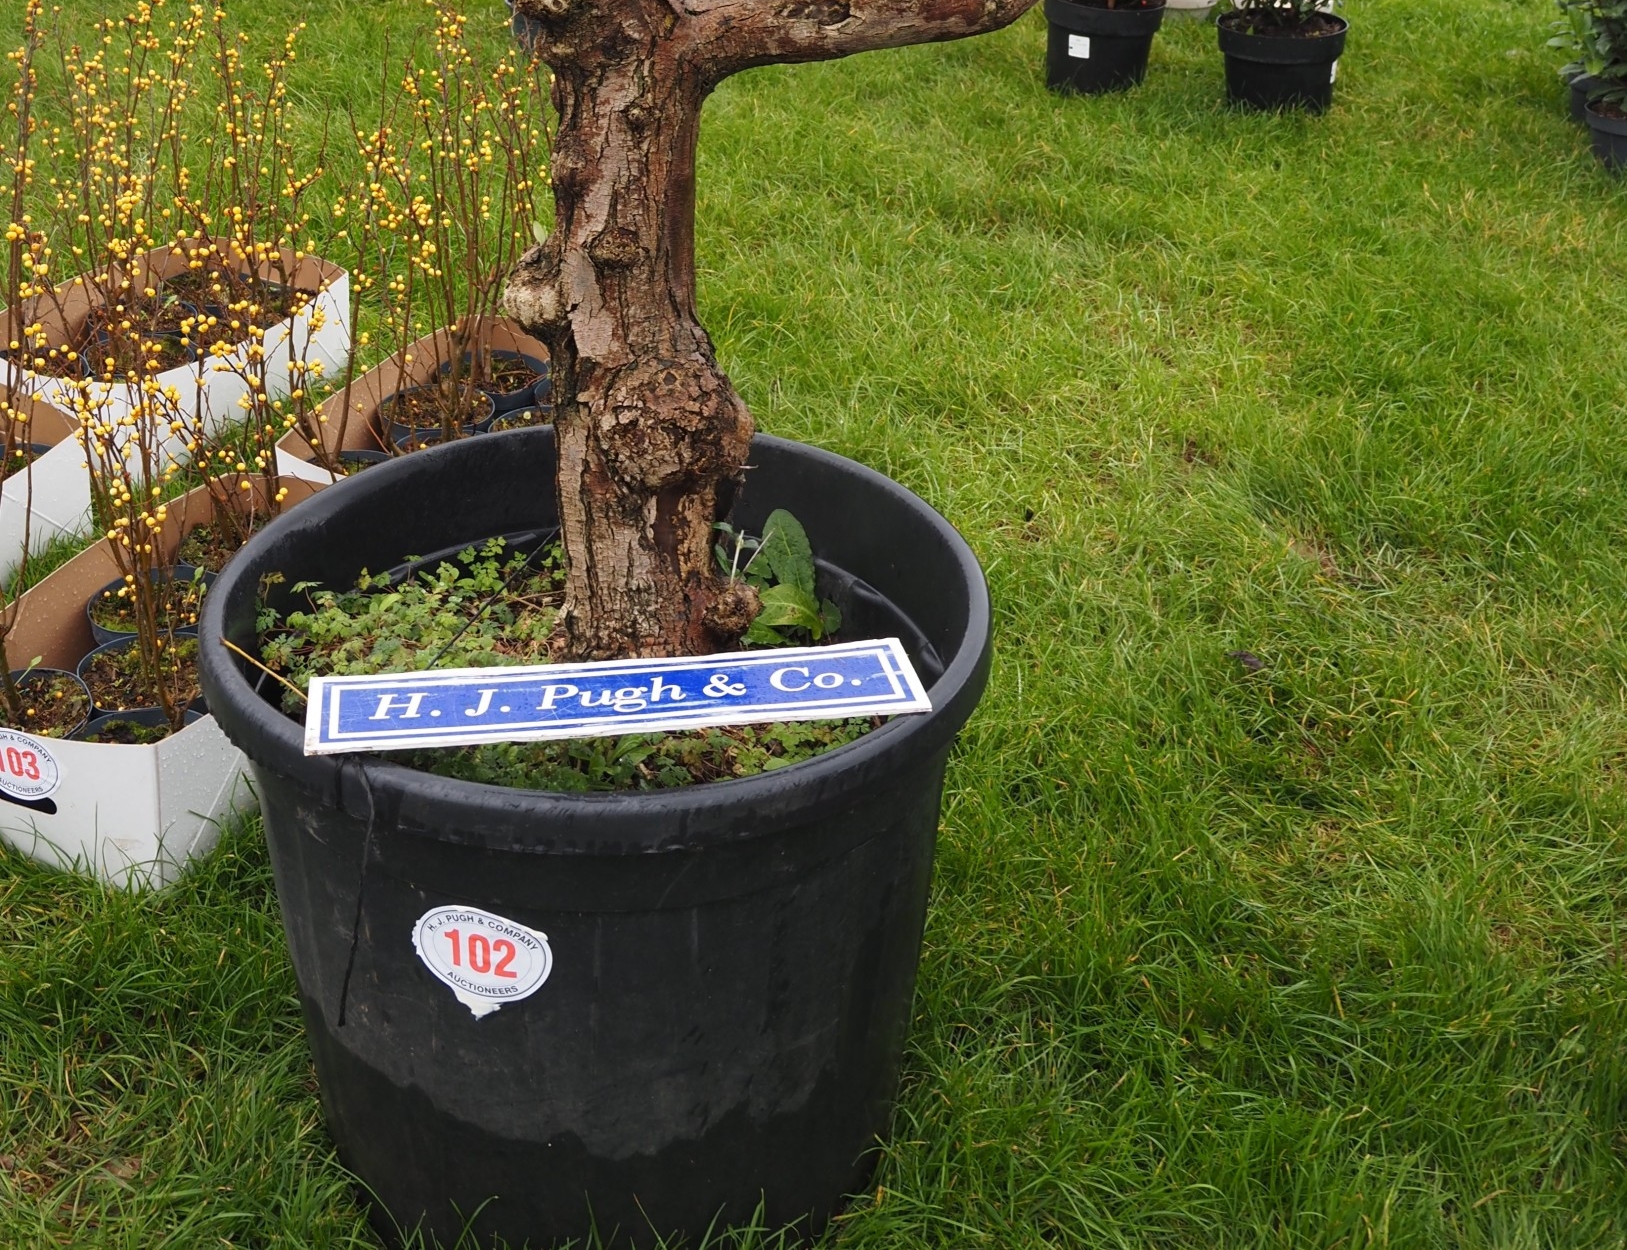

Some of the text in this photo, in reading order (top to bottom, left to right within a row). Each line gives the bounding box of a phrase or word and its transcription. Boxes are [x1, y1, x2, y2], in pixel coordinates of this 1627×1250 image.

[368, 666, 863, 720] H. J. Pugh & Co.
[17, 736, 52, 763] COMPANY
[0, 777, 44, 794] UCTIONEERS
[427, 914, 539, 951] H. J. PUGH & COMPANY
[444, 928, 518, 979] 102
[447, 971, 519, 995] AUCTIONEERS
